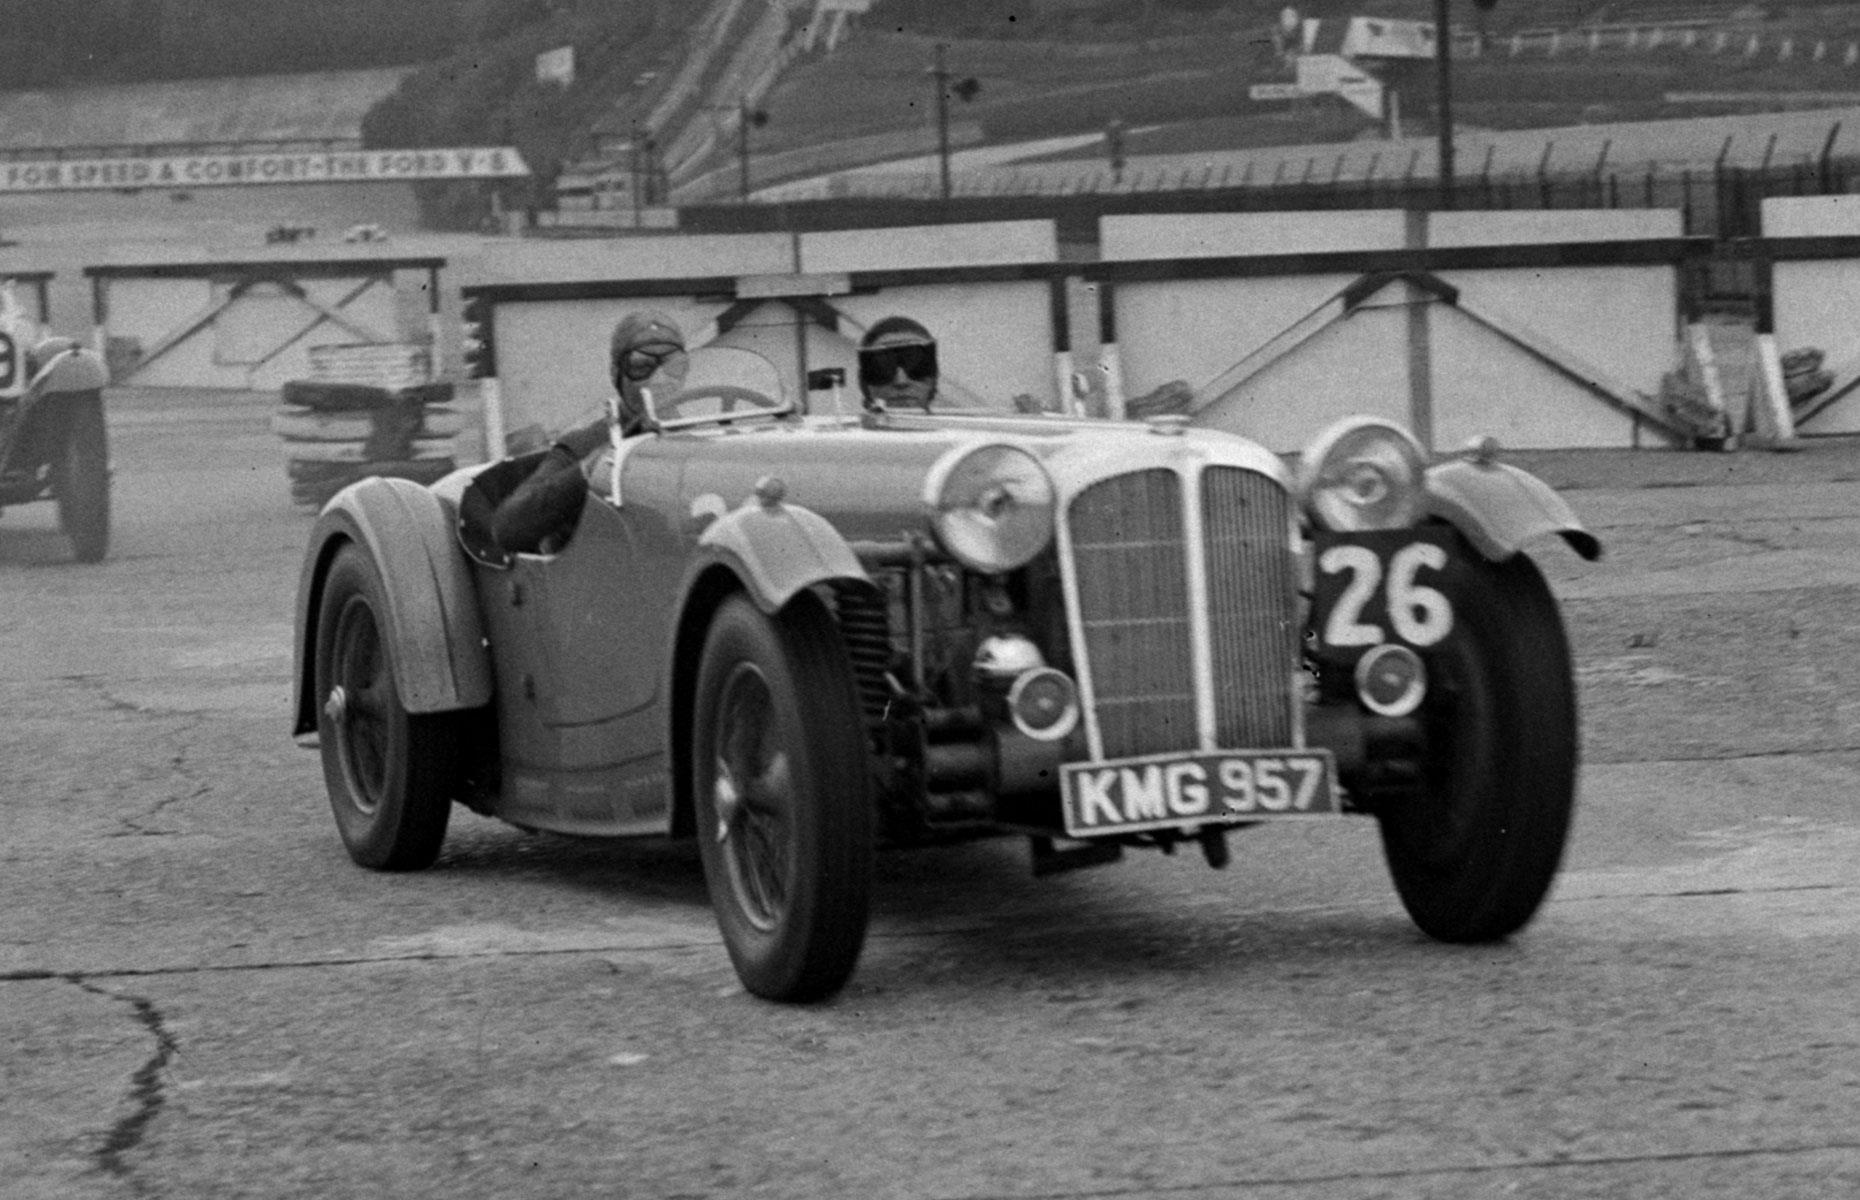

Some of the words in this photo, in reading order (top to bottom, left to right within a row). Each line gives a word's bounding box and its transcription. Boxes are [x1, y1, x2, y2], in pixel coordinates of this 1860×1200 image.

[380, 154, 447, 174] FORD
[1319, 541, 1454, 646] 26
[1078, 761, 1210, 825] KMG
[1218, 758, 1323, 811] 957
